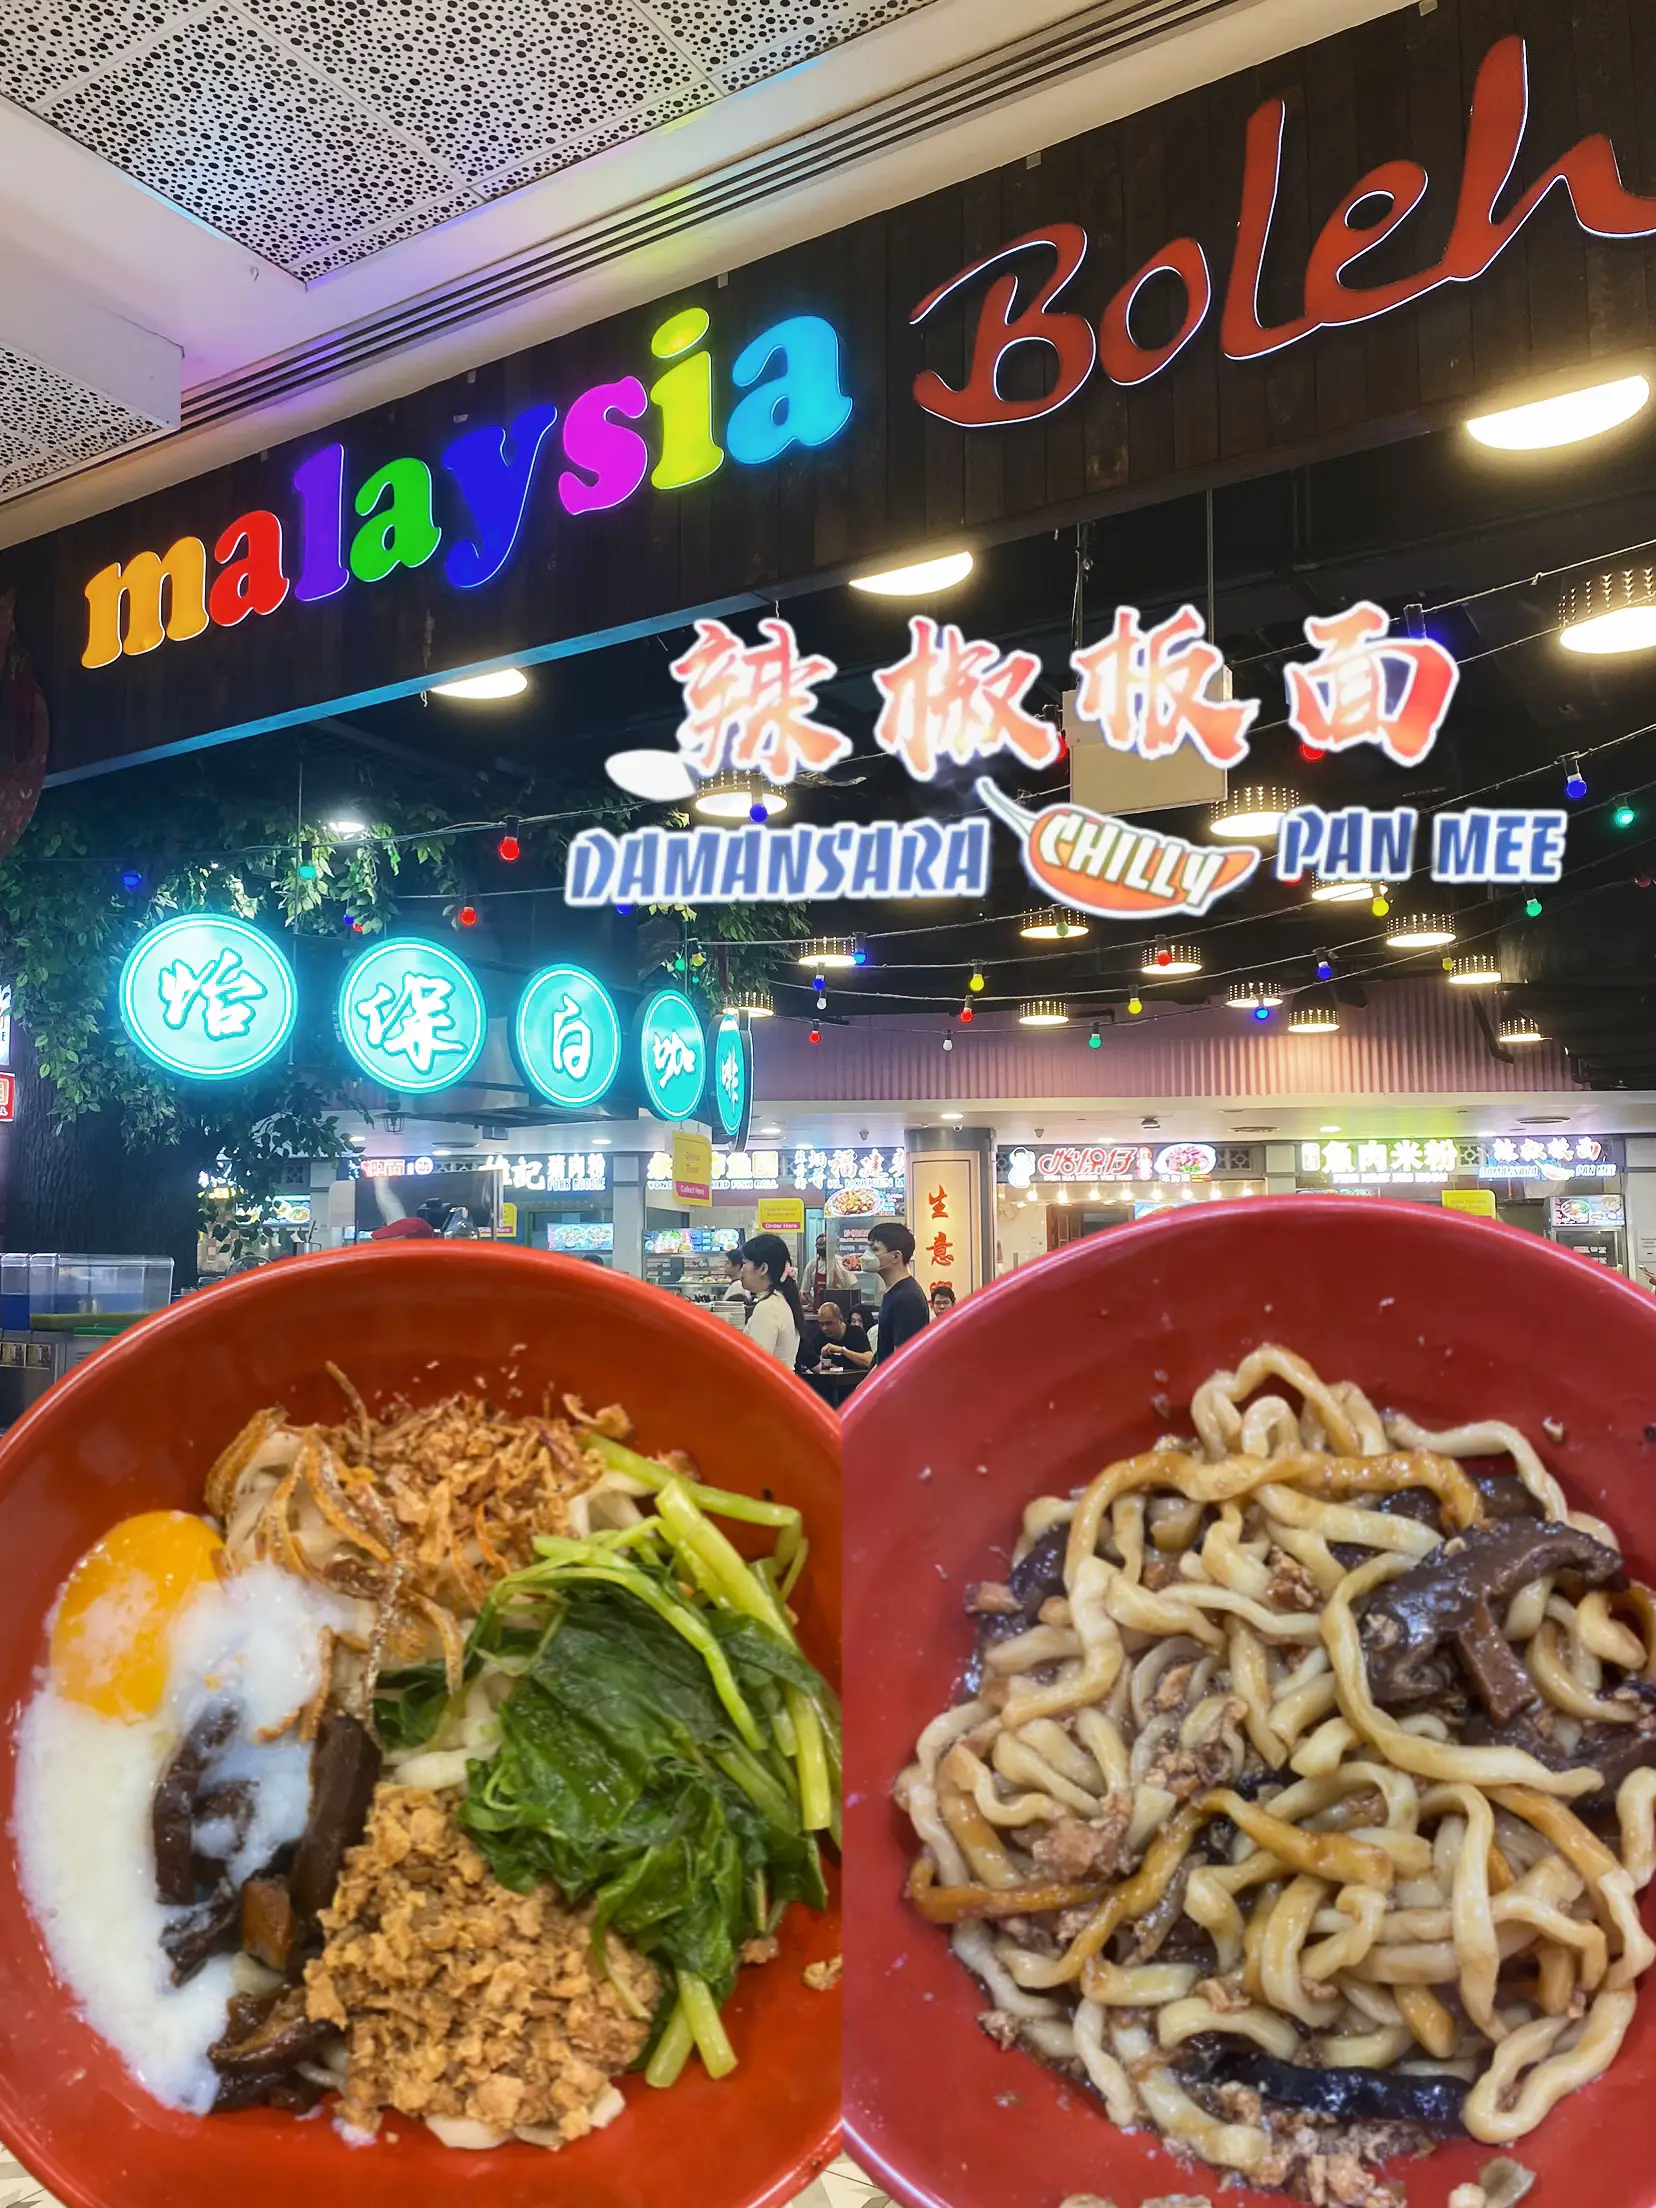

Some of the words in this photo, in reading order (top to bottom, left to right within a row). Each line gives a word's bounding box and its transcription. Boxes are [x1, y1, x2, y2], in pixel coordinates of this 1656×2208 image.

[81, 307, 853, 669] malaysia
[909, 34, 1656, 428] Boleh
[680, 1184, 695, 1194] Collect
[765, 1222, 782, 1230] Order
[783, 1222, 798, 1230] Here
